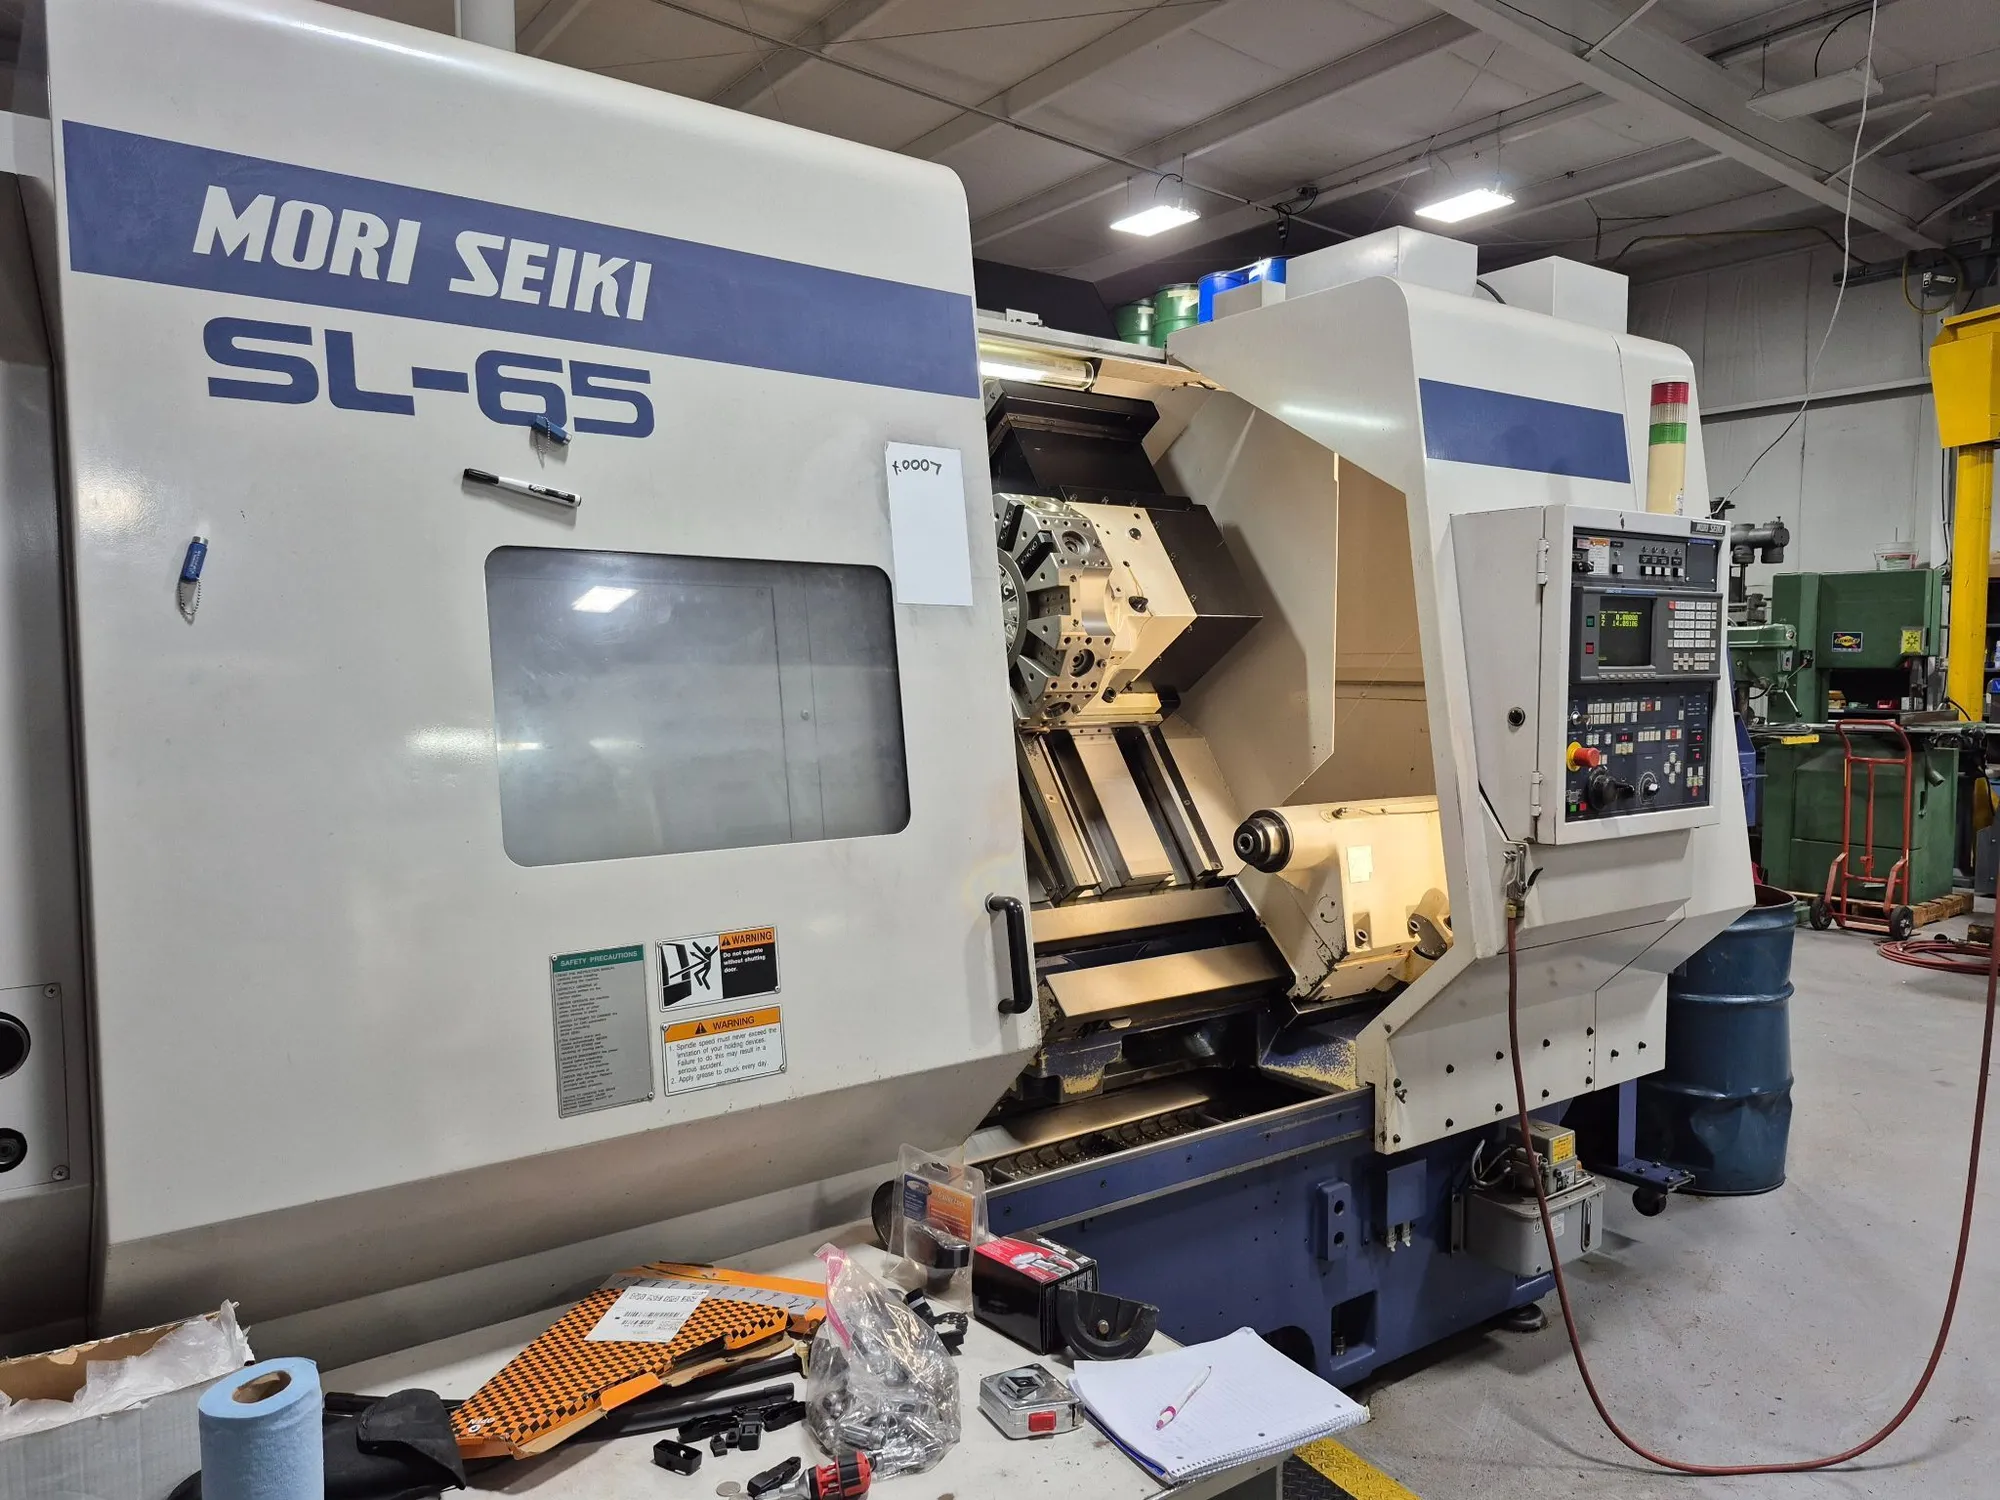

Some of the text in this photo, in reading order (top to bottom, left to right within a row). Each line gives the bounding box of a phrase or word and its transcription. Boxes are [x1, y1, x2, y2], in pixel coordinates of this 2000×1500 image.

[192, 185, 652, 321] MORI SEIKI
[202, 316, 656, 439] SL-65
[731, 931, 773, 945] WARNING
[560, 950, 638, 967] SAFETY PRECAUTIONS
[742, 947, 763, 955] operate
[723, 954, 766, 966] without shutting
[712, 1015, 755, 1031] WARNING
[676, 1041, 697, 1051] Spindle
[699, 1039, 716, 1049] speed
[717, 1035, 731, 1043] must
[732, 1033, 747, 1041] never
[748, 1028, 767, 1038] exceed
[710, 1045, 722, 1054] your
[724, 1041, 744, 1051] holding
[677, 1058, 695, 1068] Failure
[697, 1056, 704, 1064] to
[726, 1050, 738, 1058] may
[739, 1047, 754, 1055] result
[678, 1066, 697, 1075] serious
[678, 1074, 694, 1084] Apply
[696, 1072, 714, 1081] grease
[724, 1065, 740, 1074] chuck
[741, 1063, 756, 1072] every
